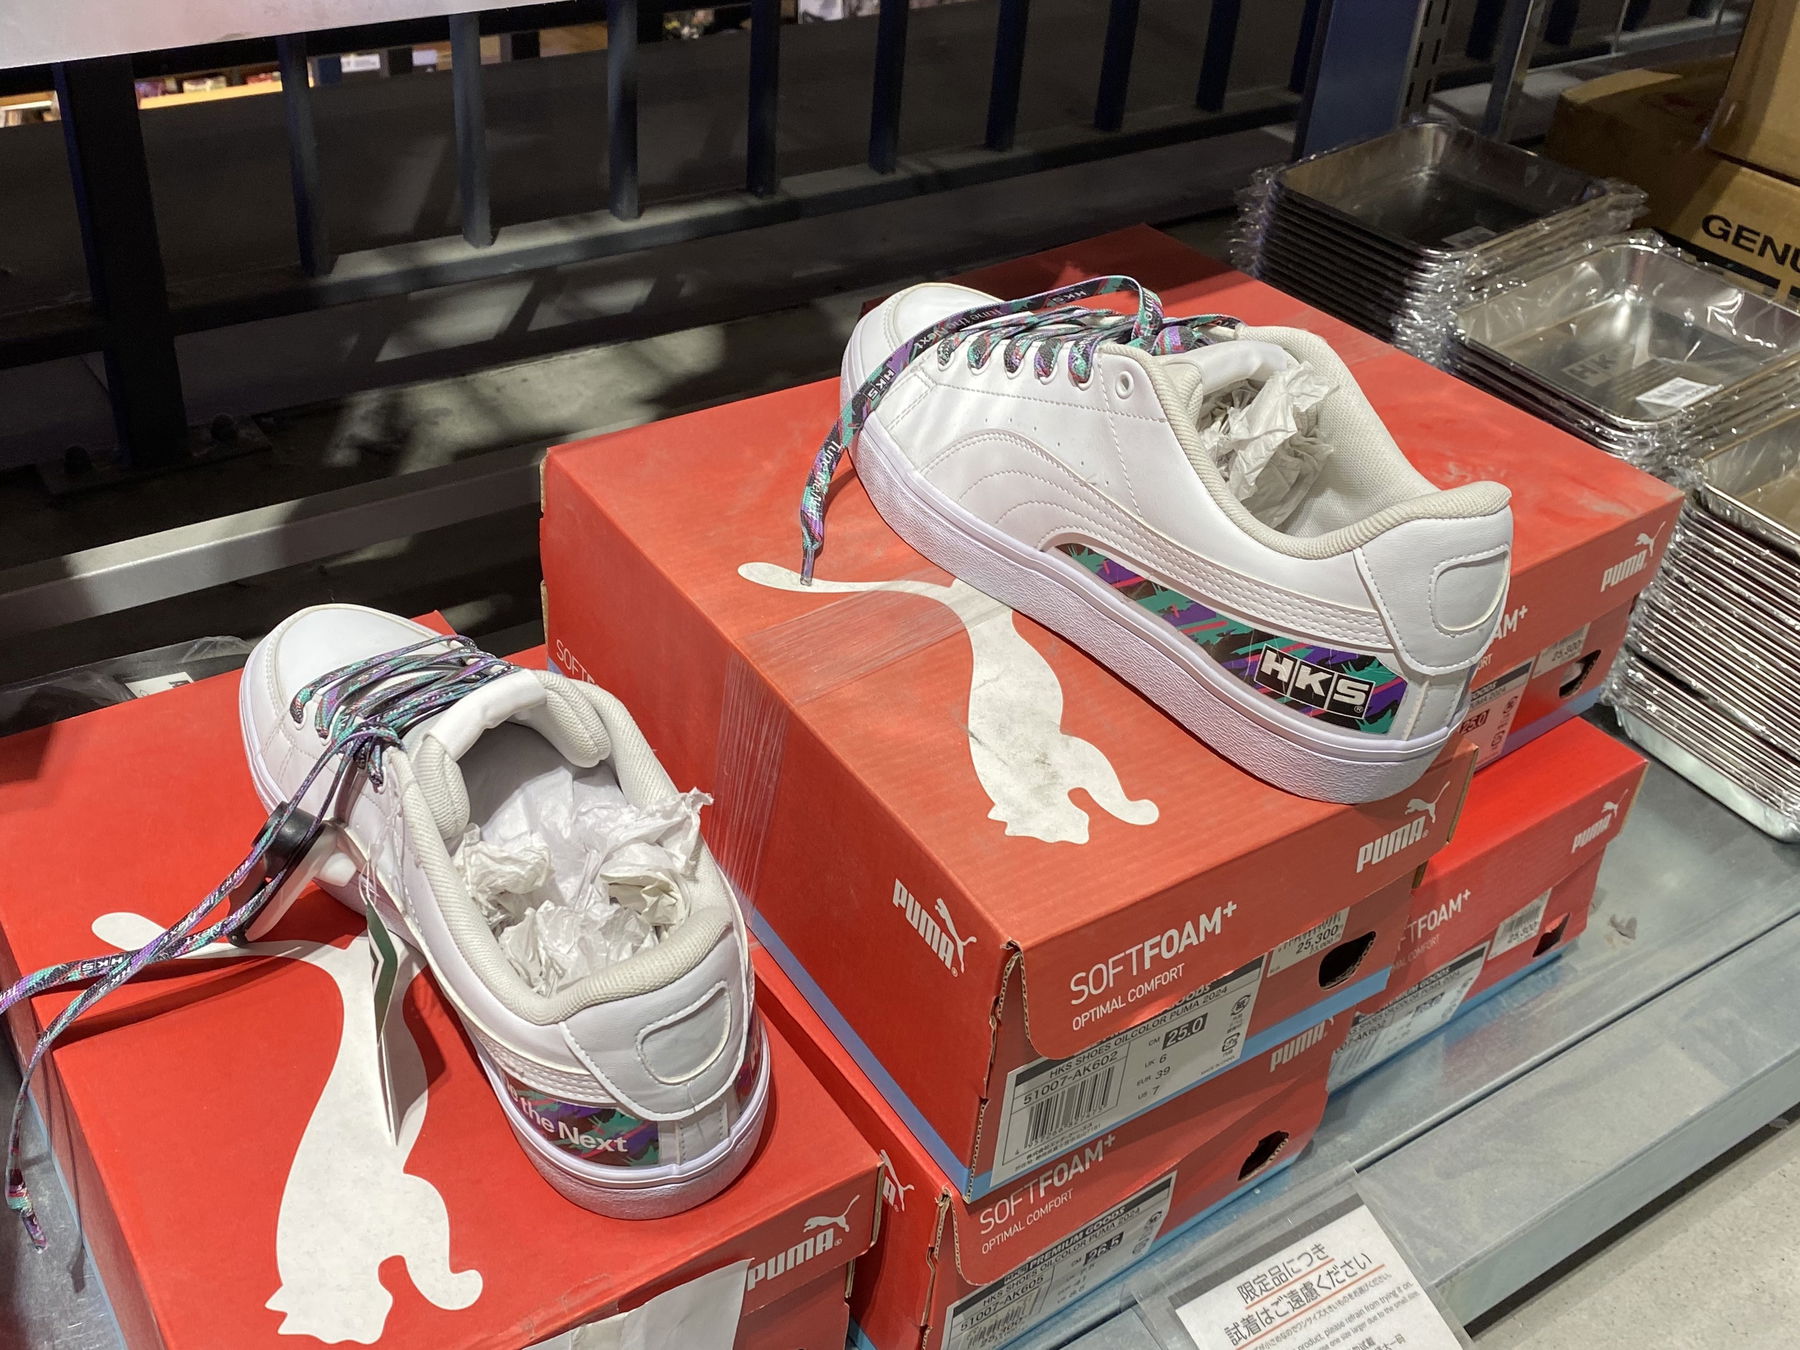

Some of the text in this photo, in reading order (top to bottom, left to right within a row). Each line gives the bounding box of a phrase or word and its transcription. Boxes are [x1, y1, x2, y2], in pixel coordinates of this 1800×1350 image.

[1051, 289, 1088, 305] HKS
[868, 368, 895, 400] HKS
[1600, 549, 1648, 592] PUMA
[1259, 648, 1370, 708] HKS
[1356, 815, 1427, 874] PUMA
[1571, 811, 1613, 853] PUMA
[892, 878, 955, 971] PUMA
[82, 956, 124, 972] HKS
[1072, 963, 1185, 1031] OPTIMAL COMFORT
[1049, 1060, 1073, 1079] HKS
[1075, 1042, 1111, 1067] SHOES
[1169, 1000, 1200, 1020] PUMA
[1202, 986, 1228, 1004] 2024
[1159, 1053, 1168, 1064] 6
[1165, 1015, 1204, 1048] 25.0
[1270, 1019, 1326, 1073] PUMA
[1023, 1050, 1119, 1106] 51007-AK602
[1152, 1085, 1161, 1096] 7
[1155, 1066, 1171, 1080] 39
[520, 1096, 629, 1153] the Next
[981, 1187, 1075, 1255] OPTIMAL COMFORT
[1029, 1232, 1084, 1270] PREMIUM
[1085, 1206, 1127, 1236] GOODS
[747, 1227, 835, 1291] PUMA
[982, 1291, 1004, 1307] HKS
[1006, 1269, 1038, 1291] SHOES
[1088, 1222, 1116, 1243] PUMA
[1236, 1243, 1331, 1305] 限定品につき
[959, 1275, 1044, 1332] 51007-AK605
[1223, 1253, 1372, 1346] 試着はご遠慮ください
[1364, 1299, 1380, 1313] from
